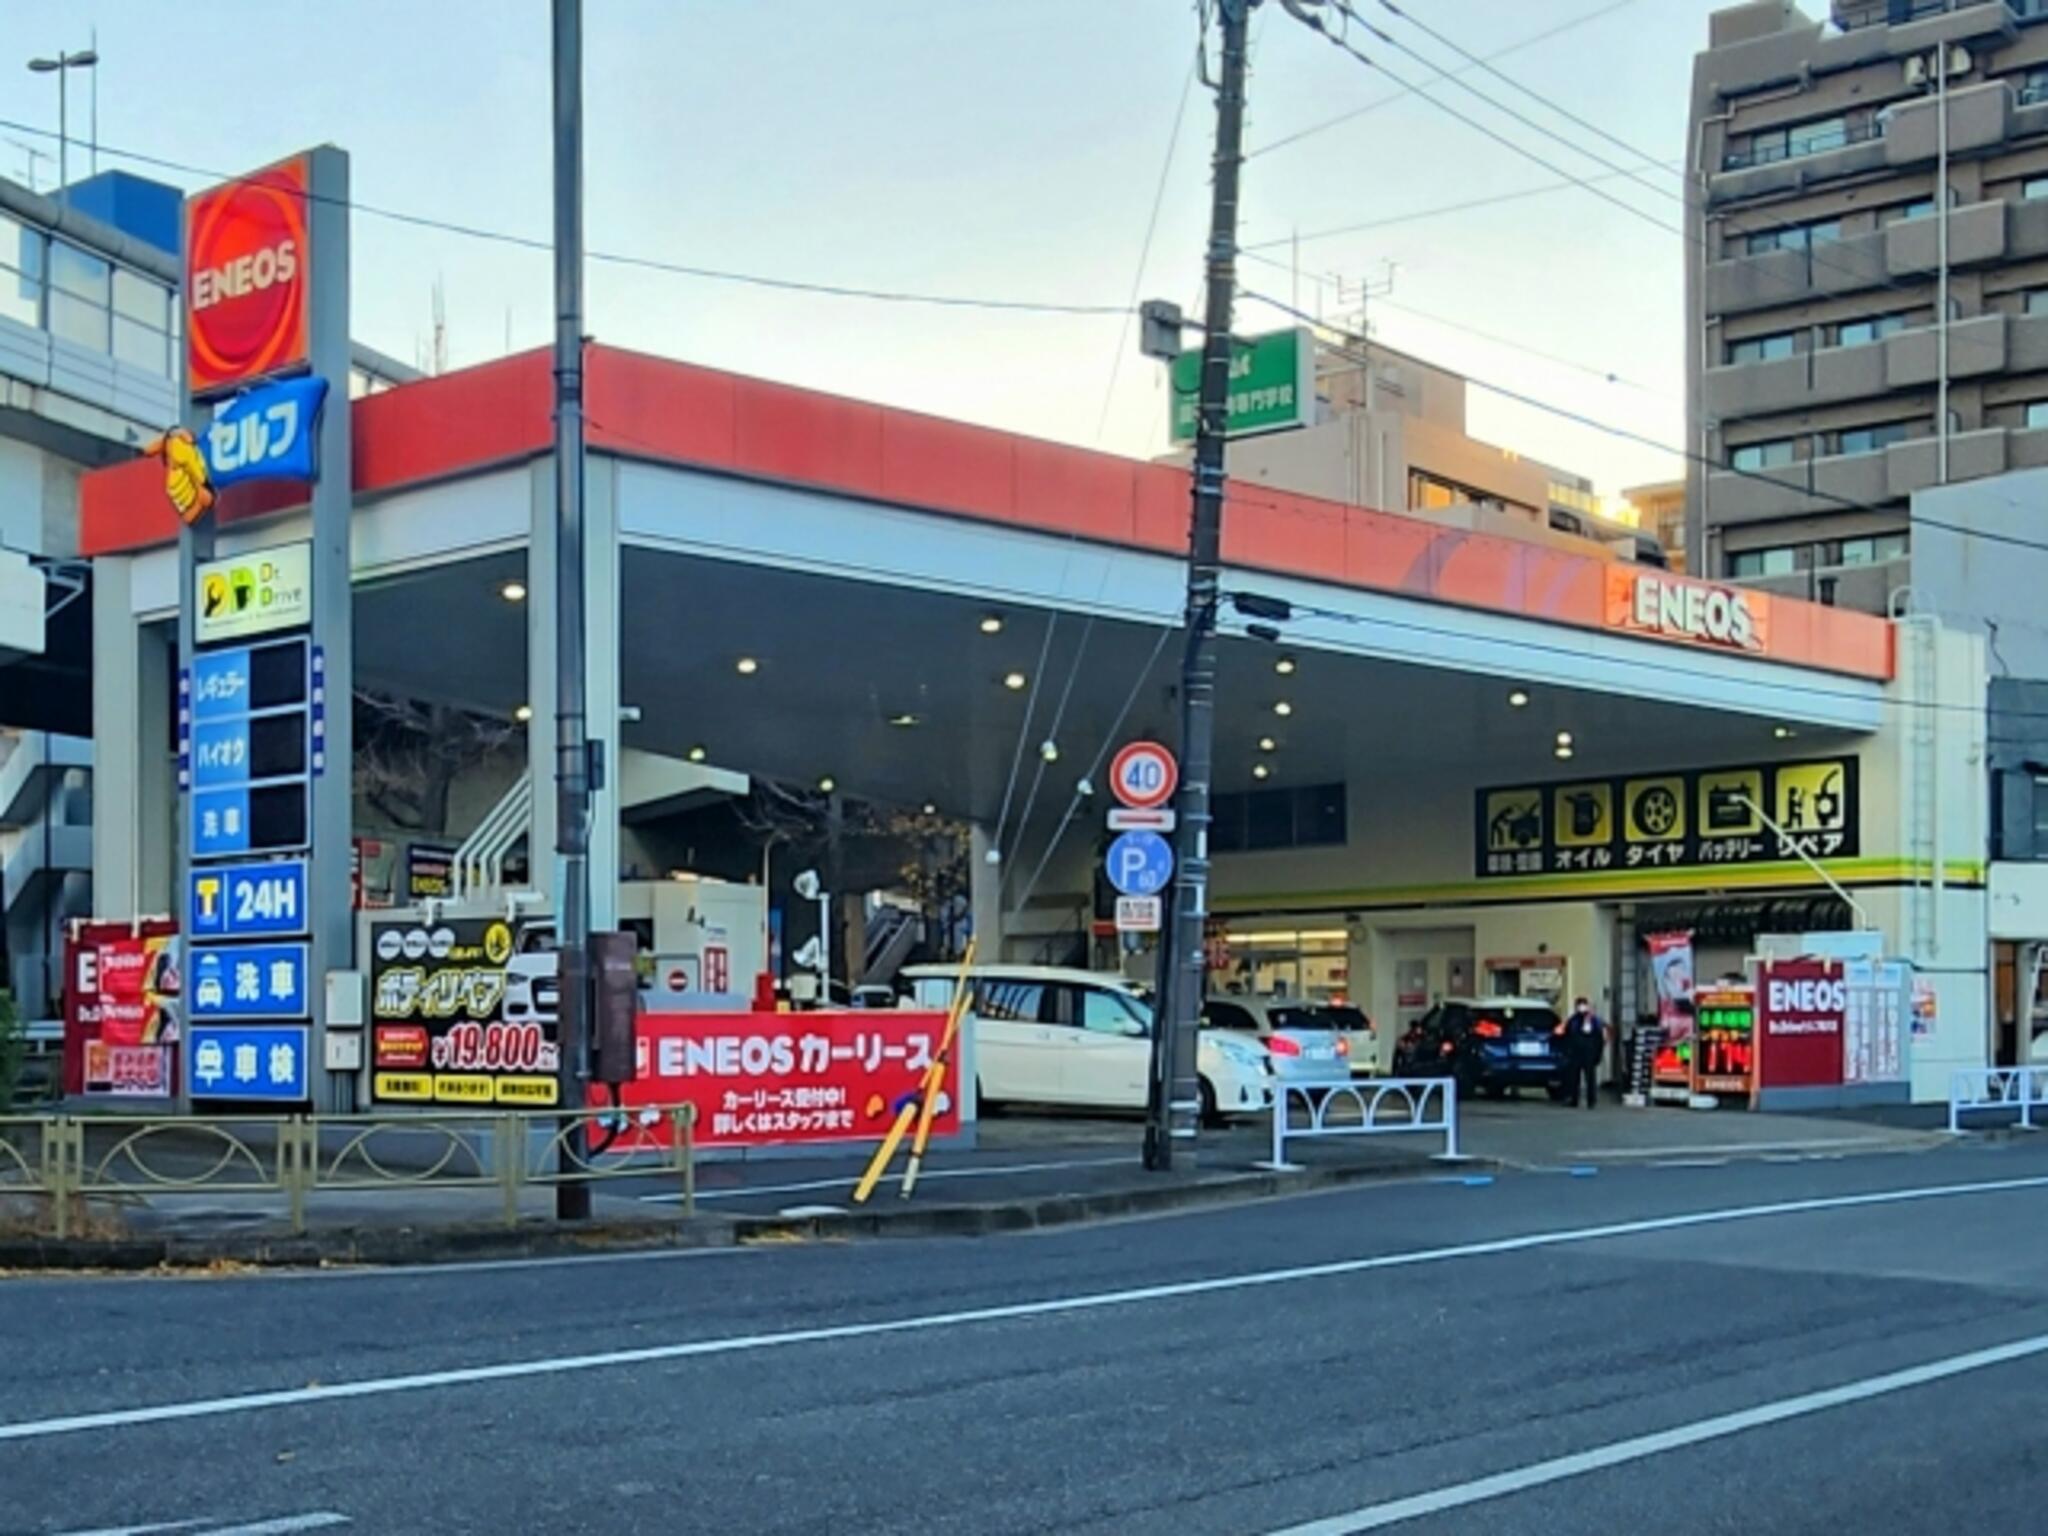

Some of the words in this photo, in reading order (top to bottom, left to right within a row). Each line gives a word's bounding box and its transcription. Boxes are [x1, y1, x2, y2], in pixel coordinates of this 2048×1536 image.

[192, 239, 297, 311] ENEOS
[208, 400, 298, 471] セルフ
[1635, 574, 1754, 646] ENEOS
[197, 737, 245, 768] ハイオク
[1126, 761, 1162, 791] 40
[1120, 847, 1147, 890] P
[1554, 846, 1611, 869] オイル
[1625, 843, 1684, 866] タイヤ
[1699, 839, 1763, 862] バッテリー
[235, 878, 296, 922] 24H
[235, 960, 295, 1002] 洗車
[374, 966, 506, 1018] ボディリペア
[1768, 979, 1845, 1013] ENEOS
[234, 1042, 295, 1084] 車検
[657, 1035, 794, 1077] ENEOS
[799, 1032, 931, 1073] カーリース
[712, 1108, 855, 1135] 詳しくはスタッフまで
